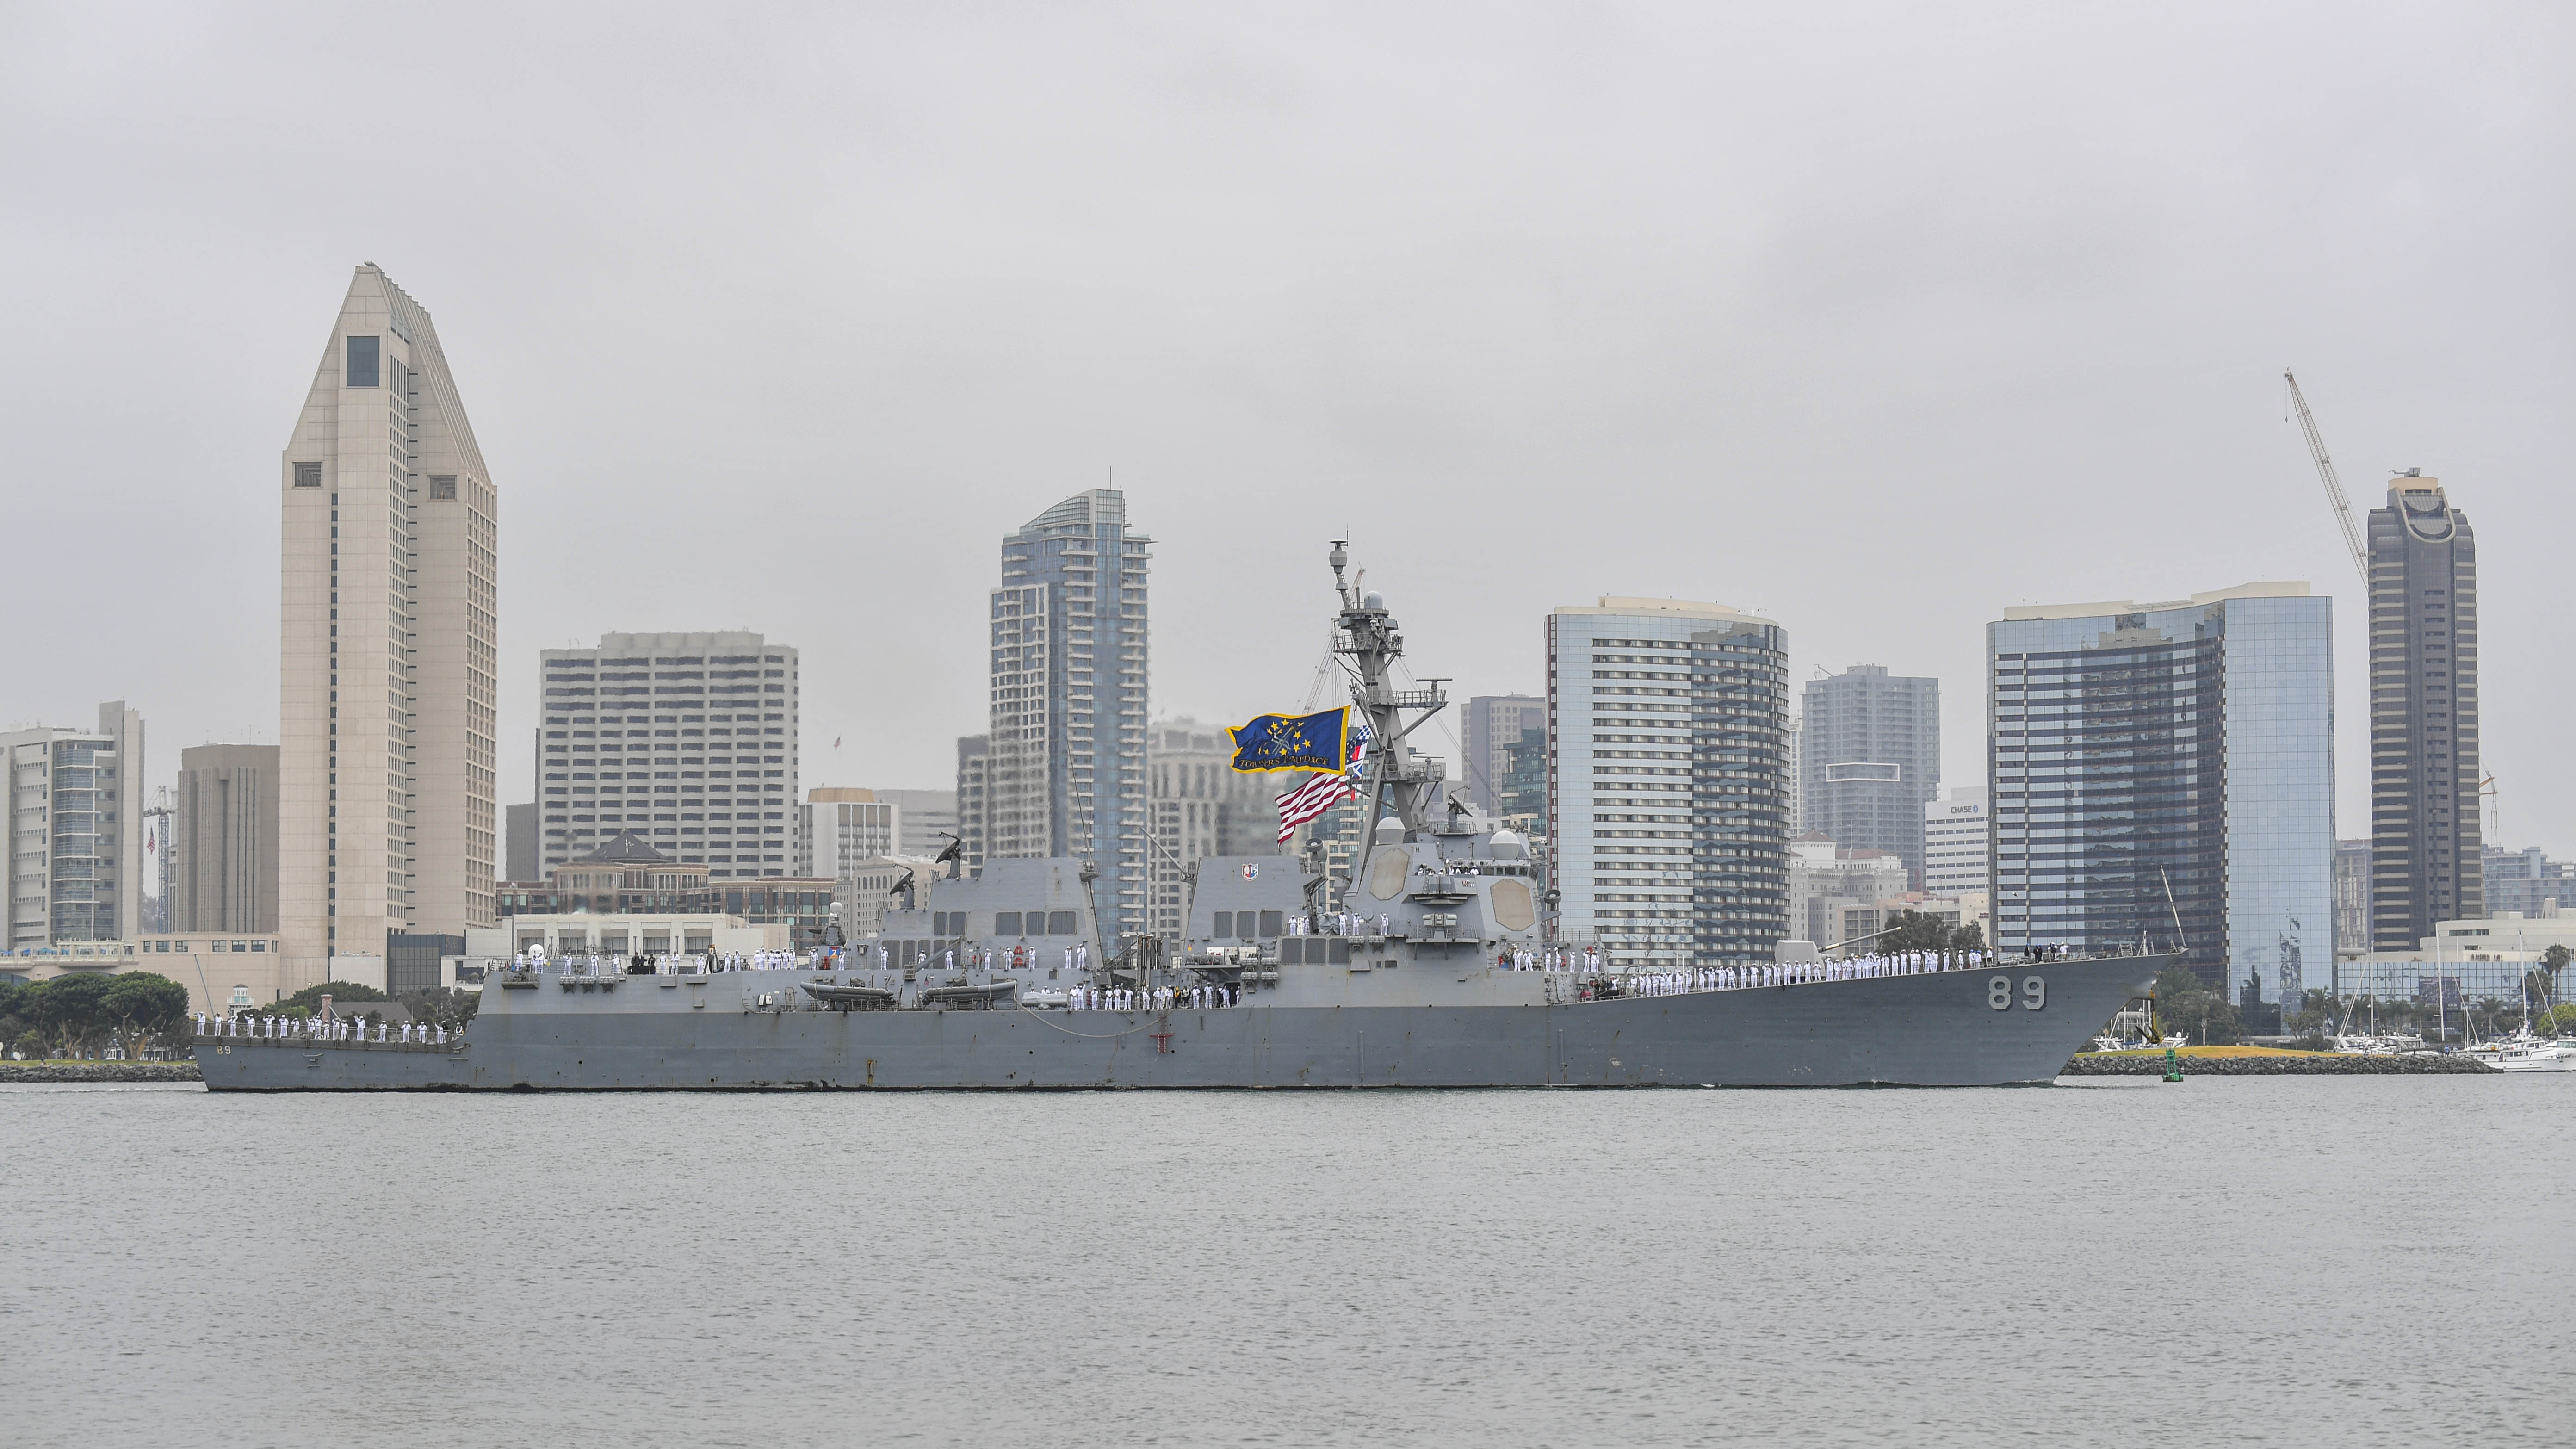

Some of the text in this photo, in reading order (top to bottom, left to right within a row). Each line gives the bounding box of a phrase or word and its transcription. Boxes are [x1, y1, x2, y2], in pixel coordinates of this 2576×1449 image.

[1251, 866, 1257, 874] 15
[1988, 976, 2045, 1009] 89
[217, 1046, 231, 1054] 89
